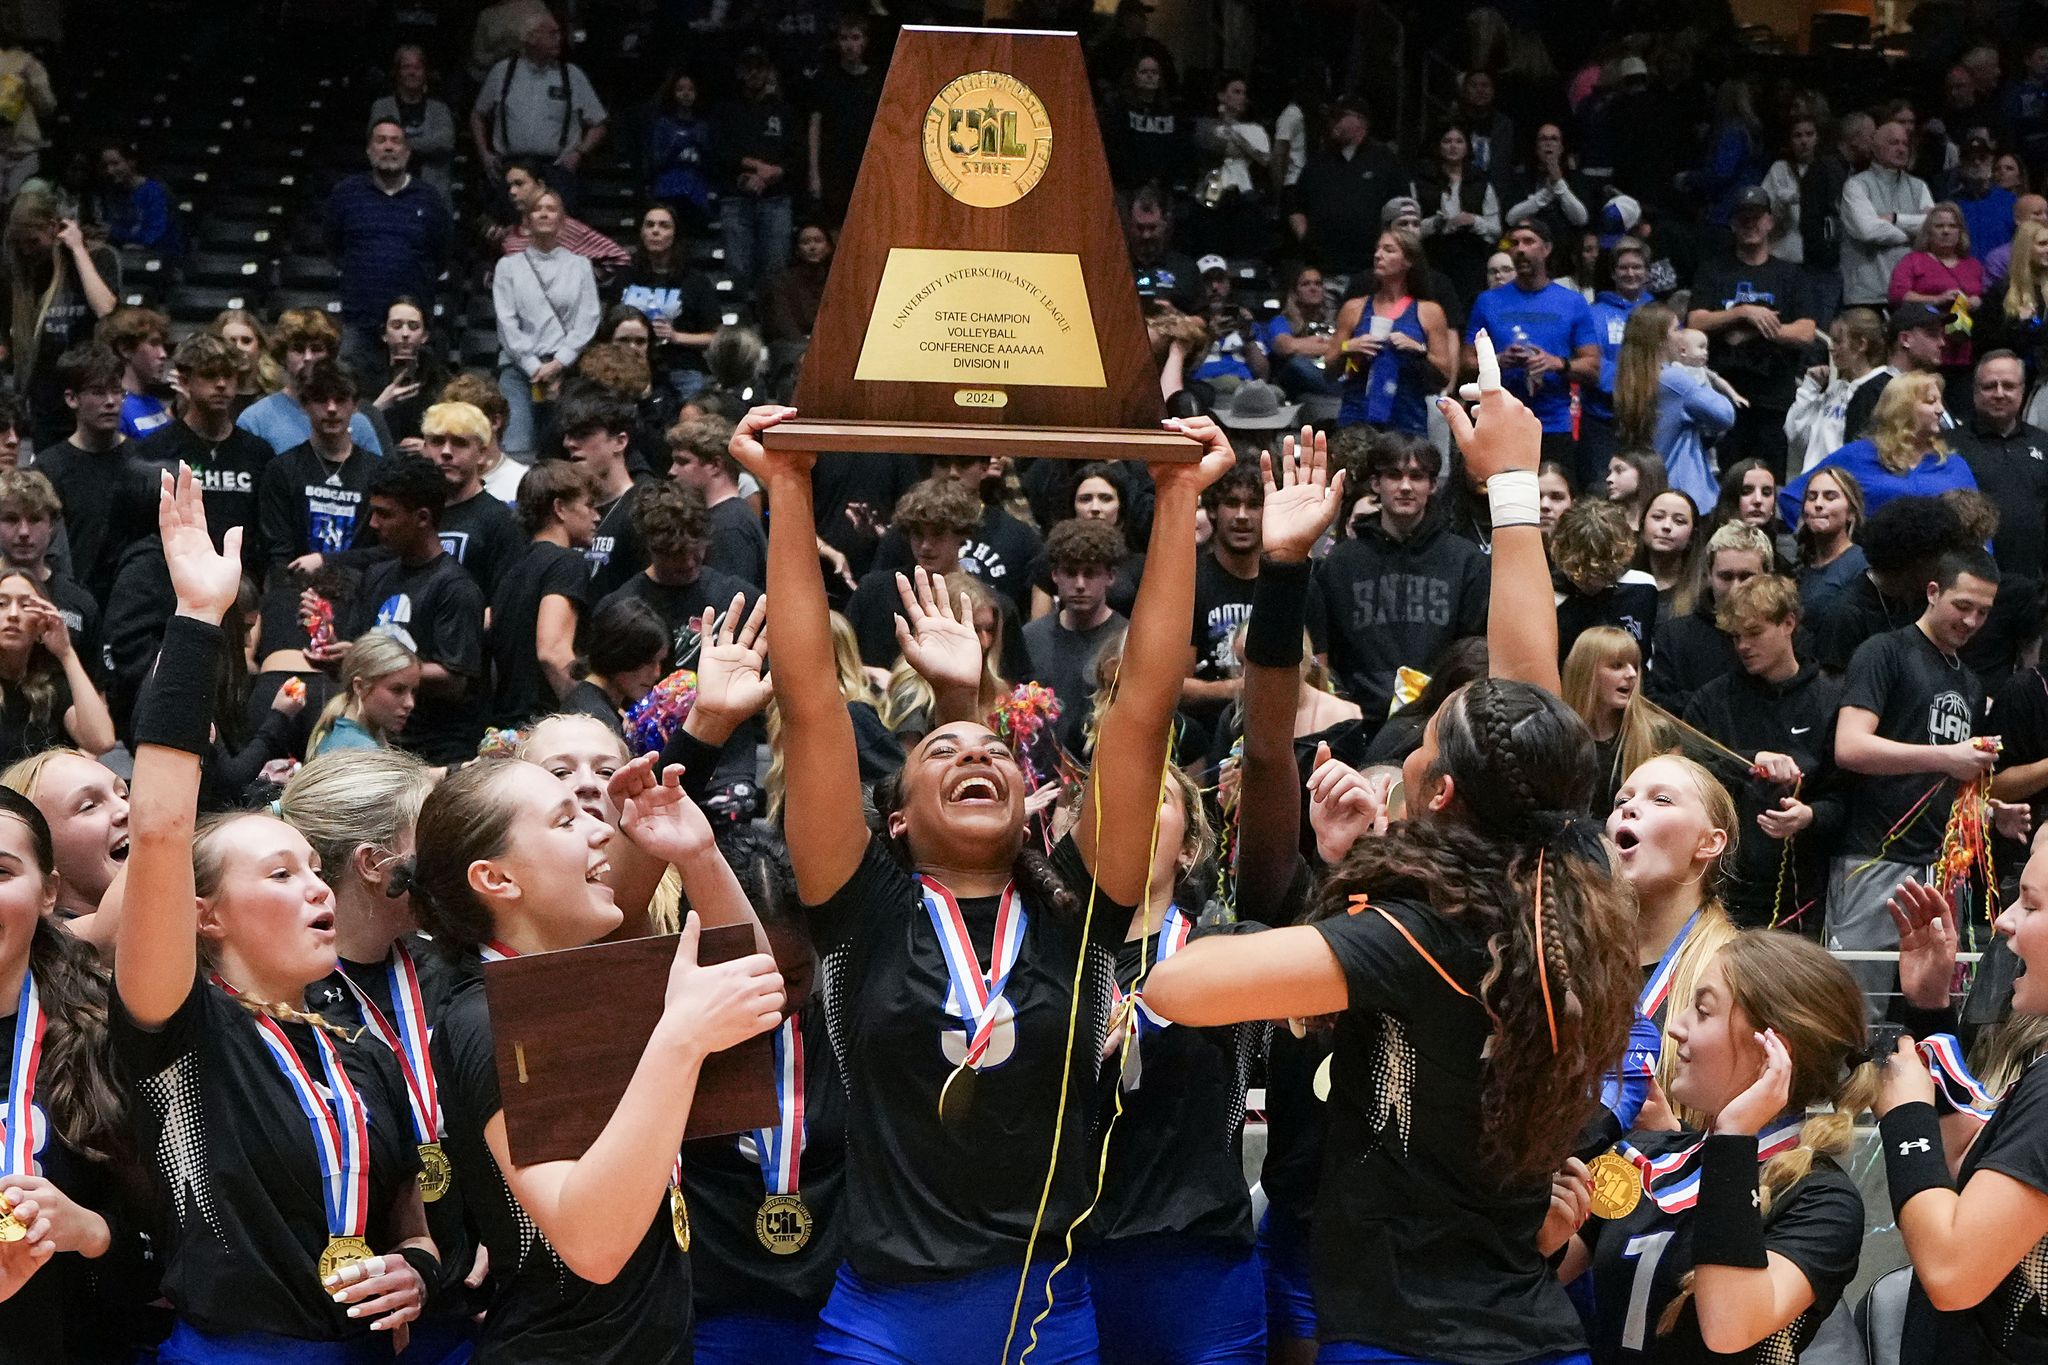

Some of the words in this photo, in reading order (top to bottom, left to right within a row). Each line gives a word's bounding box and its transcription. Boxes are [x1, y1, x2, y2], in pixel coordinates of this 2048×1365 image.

[961, 161, 1012, 177] STATE
[892, 277, 943, 329] UNIVERSITY
[945, 267, 1042, 297] INTERSCHOLASTIC
[1040, 294, 1071, 335] LEAGUE
[934, 311, 967, 322] STATE
[970, 312, 1031, 324] CHAMPION
[947, 327, 1016, 339] VOLLEYBALL
[919, 341, 994, 354] CONFERENCE
[997, 343, 1044, 355] AAAAAA
[953, 358, 1001, 369] DIVISION
[1003, 359, 1009, 369] II
[966, 392, 995, 404] 2024
[305, 485, 362, 503] BOBCATS
[766, 1208, 802, 1234] UIL
